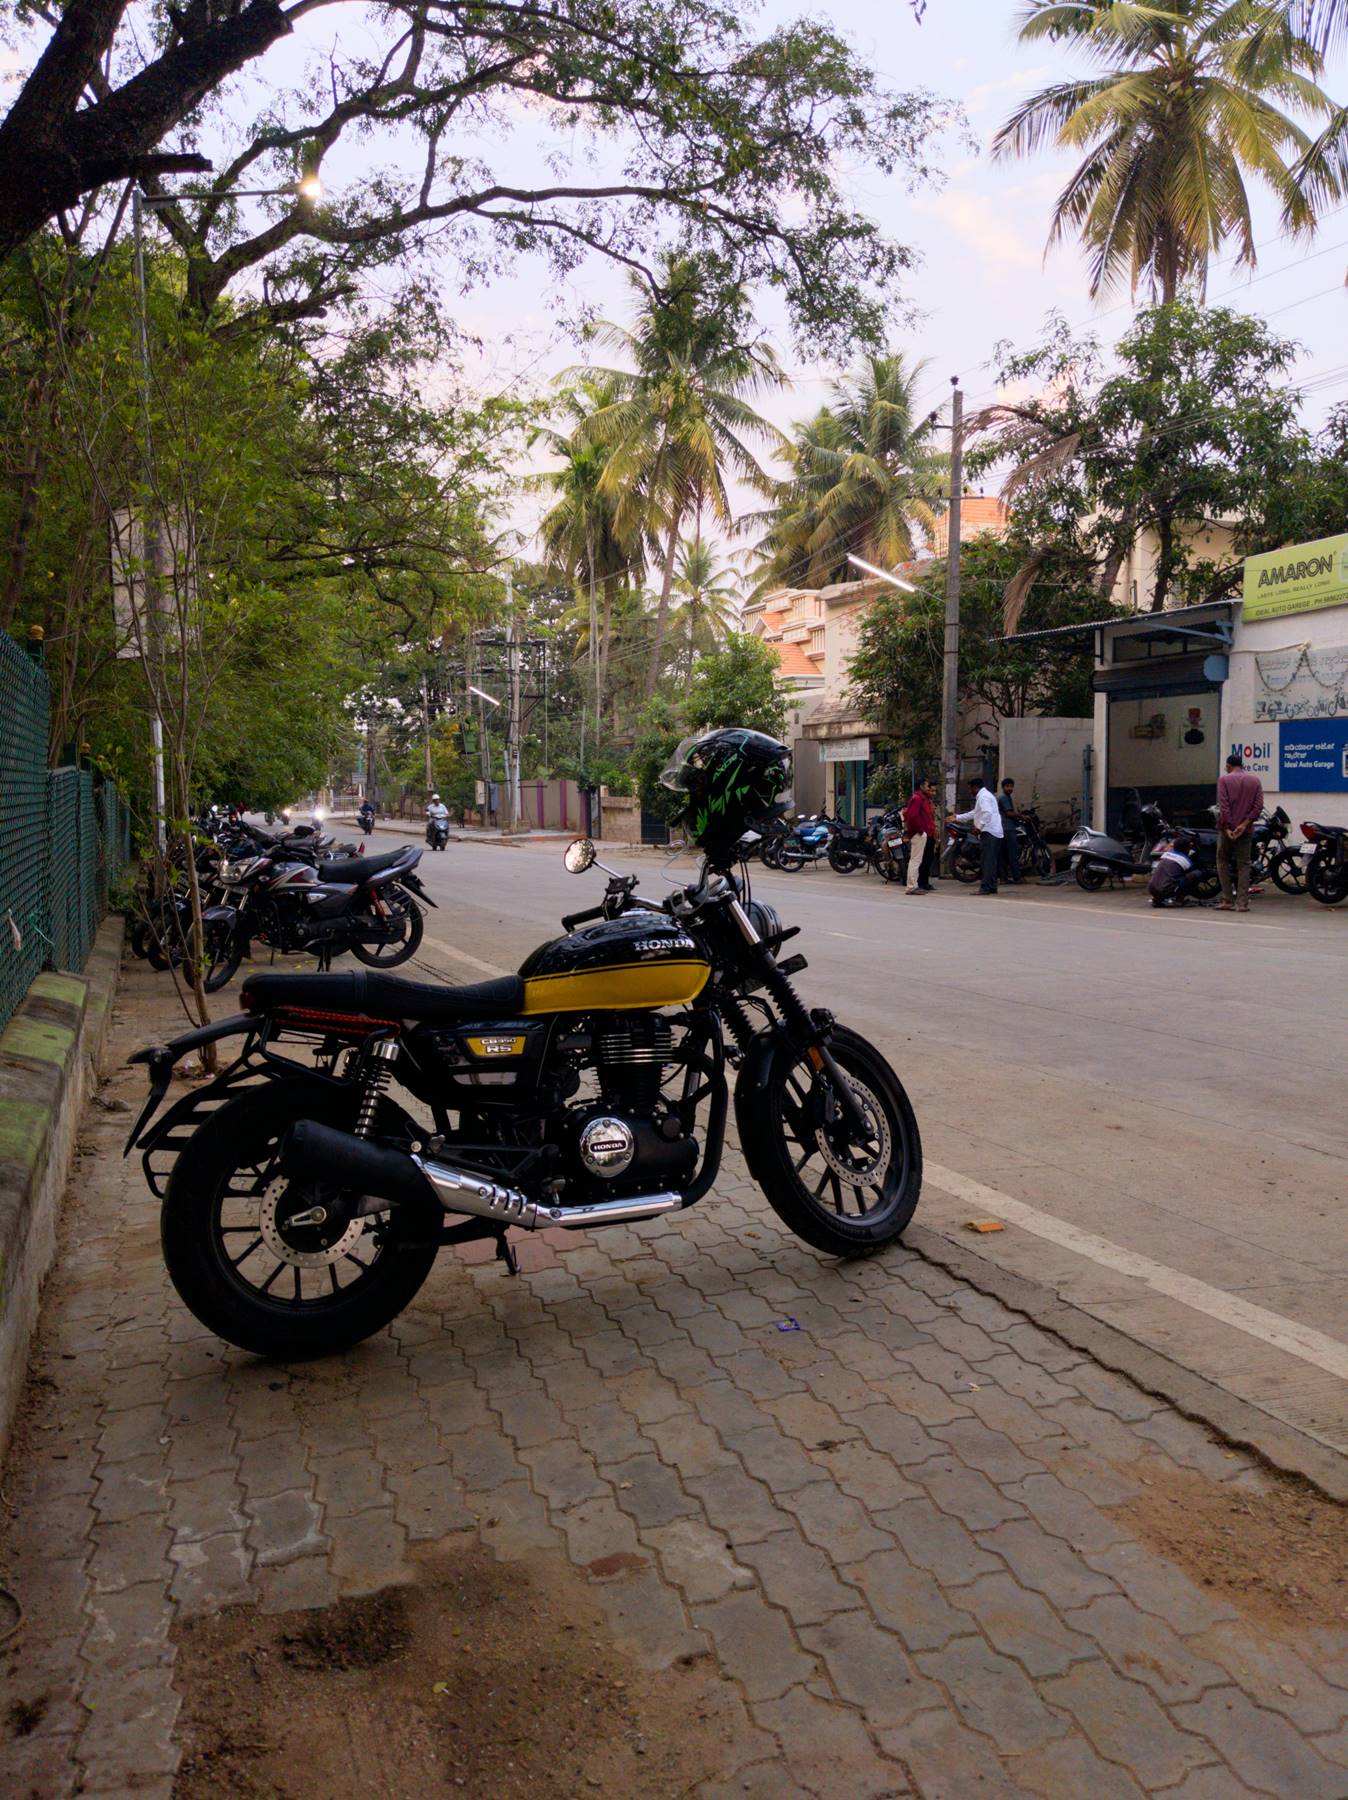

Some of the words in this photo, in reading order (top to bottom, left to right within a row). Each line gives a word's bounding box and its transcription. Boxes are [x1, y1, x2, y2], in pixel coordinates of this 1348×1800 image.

[1258, 554, 1333, 588] AMARON
[1231, 742, 1271, 759] Mobil
[1252, 763, 1269, 772] Care
[1284, 760, 1298, 768] Ideal
[1298, 760, 1312, 768] Auto
[1314, 761, 1334, 769] Garage
[633, 938, 695, 951] HONDA
[486, 1045, 512, 1053] RS
[594, 1142, 623, 1151] HONDA
